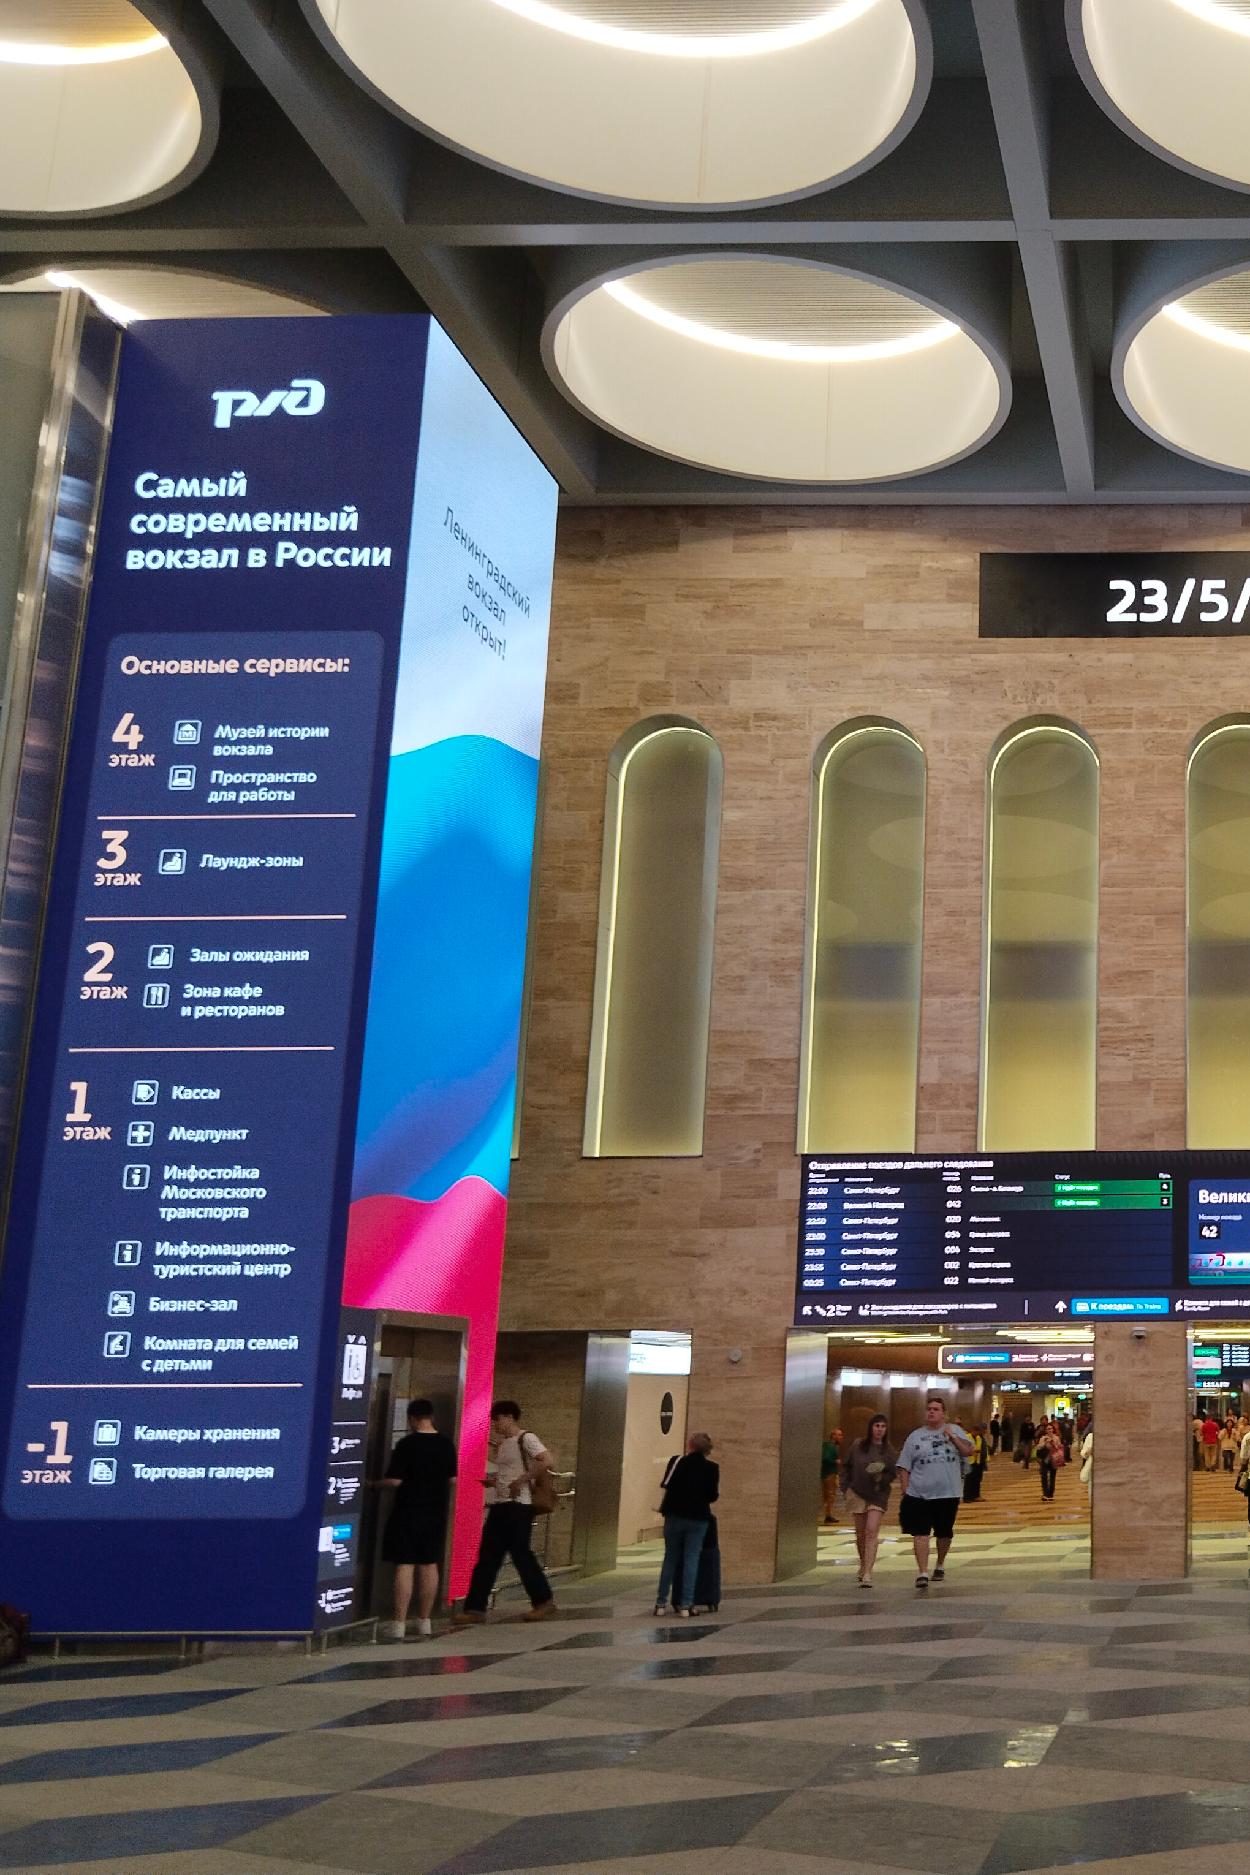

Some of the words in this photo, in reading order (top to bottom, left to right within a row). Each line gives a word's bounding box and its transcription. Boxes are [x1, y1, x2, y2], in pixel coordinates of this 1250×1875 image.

[135, 471, 247, 498] Самый
[130, 505, 359, 539] современный
[126, 547, 238, 570] вокзал
[247, 548, 266, 568] в
[275, 543, 391, 568] России
[444, 506, 531, 618] Ленинградский
[467, 573, 506, 624] вокзал
[462, 605, 507, 661] открыт!
[121, 655, 239, 675] Основные
[244, 657, 350, 676] сервисы:
[112, 713, 143, 749] 4
[214, 723, 264, 741] Музей
[268, 726, 329, 740] истории
[213, 743, 273, 757] вокзала
[108, 752, 155, 767] этаж
[210, 770, 317, 787] Пространство
[207, 789, 235, 803] для
[238, 788, 295, 803] работы
[97, 831, 128, 868] 3
[200, 853, 303, 869] Лаундж-зоны
[94, 871, 141, 886] этаж
[83, 941, 115, 982] 2
[190, 947, 230, 962] Залы
[233, 947, 309, 963] ожидания
[80, 984, 127, 1000] этаж
[183, 984, 219, 999] Зона
[224, 983, 263, 1001] кафе
[181, 1005, 191, 1016] и
[194, 1003, 285, 1019] ресторанов
[65, 1081, 92, 1122] 1
[172, 1085, 220, 1101] Кассы
[63, 1124, 111, 1141] этаж
[168, 1125, 249, 1143] Медпункт
[163, 1164, 260, 1182] Инфостойка
[161, 1184, 267, 1201] Московского
[159, 1204, 250, 1222] транспорта
[1202, 1225, 1218, 1238] 42
[155, 1241, 296, 1259] Информационно-
[153, 1260, 243, 1279] туристский
[244, 1261, 292, 1279] центр
[149, 1297, 238, 1313] Бизнес-зал
[827, 1305, 835, 1317] 2
[144, 1335, 213, 1352] Комната
[216, 1336, 246, 1353] для
[248, 1332, 299, 1351] семей
[142, 1358, 152, 1370] с
[153, 1356, 213, 1372] детьми
[134, 1424, 200, 1444] Камеры
[204, 1423, 280, 1443] хранения
[27, 1421, 73, 1465] -1
[21, 1466, 72, 1484] этаж
[132, 1463, 206, 1483] Торговая
[210, 1463, 275, 1480] галерея
